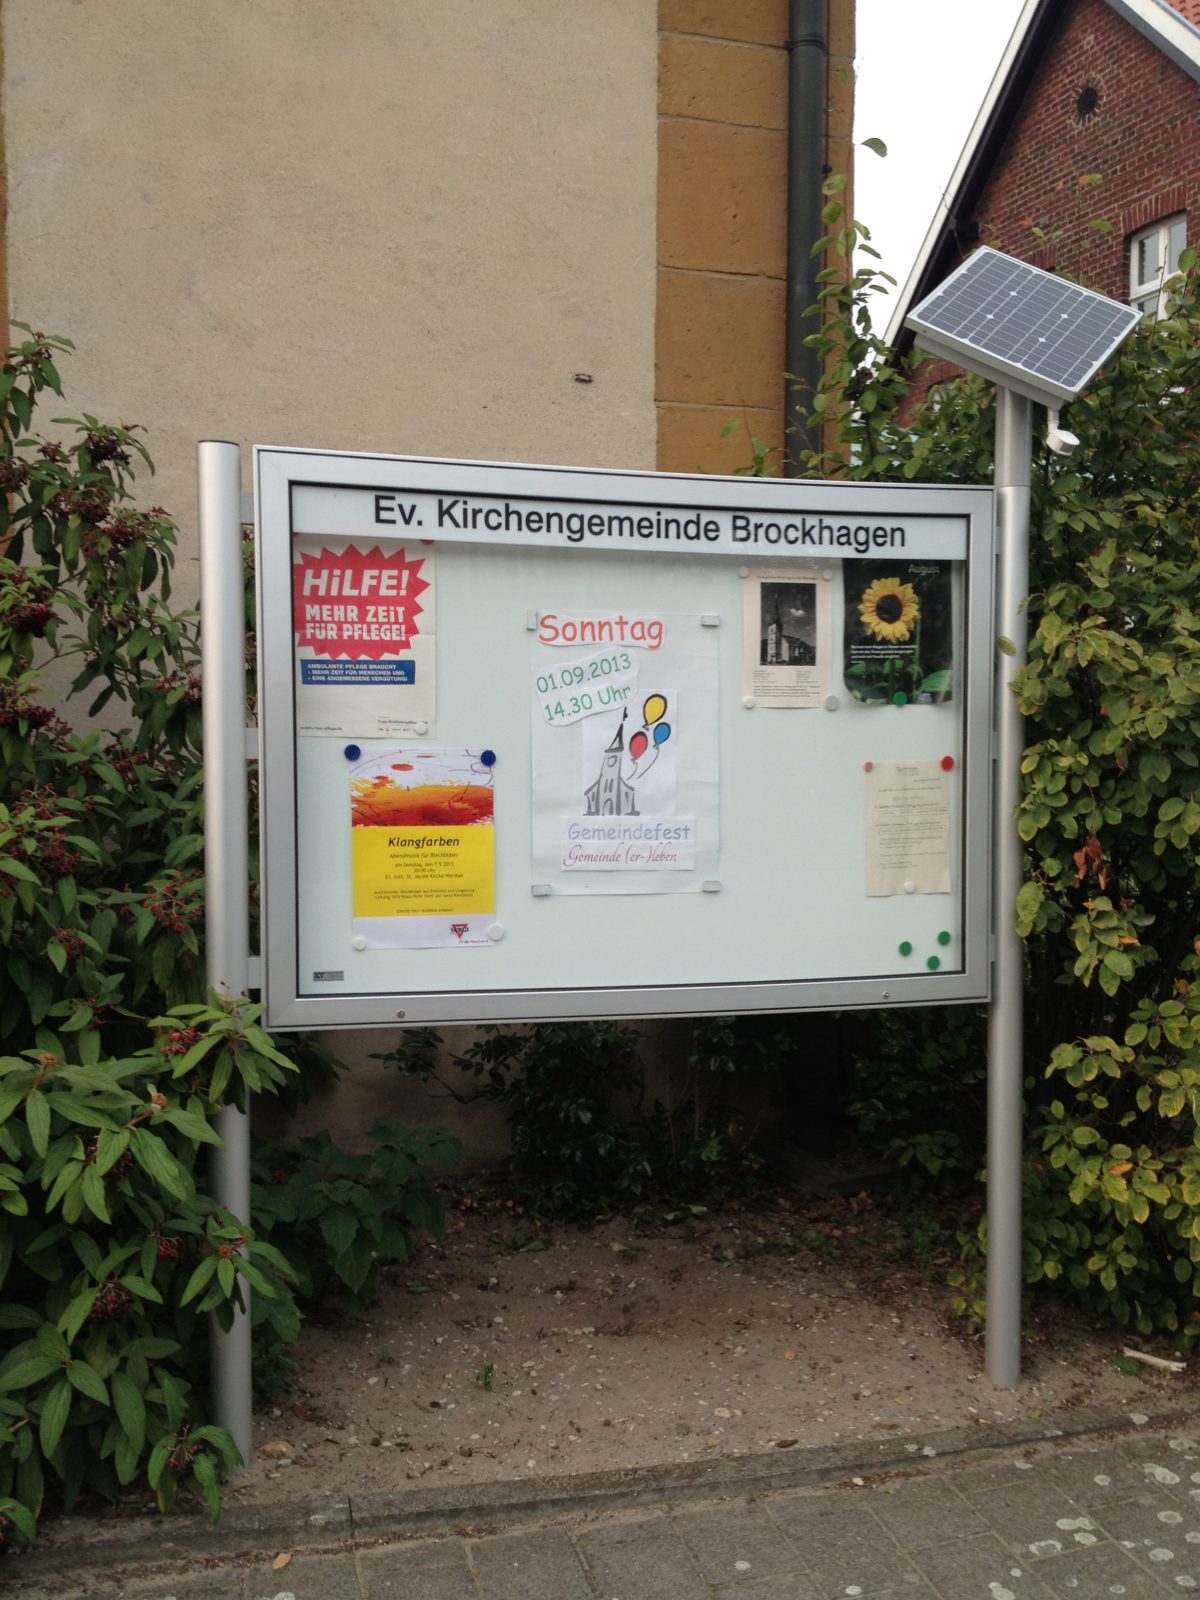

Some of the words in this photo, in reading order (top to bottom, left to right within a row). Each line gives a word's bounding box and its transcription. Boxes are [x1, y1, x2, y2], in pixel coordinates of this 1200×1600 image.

[374, 494, 423, 526] Ev.
[437, 498, 720, 542] Kirchengemeinde
[731, 514, 906, 553] Brockhagen
[305, 604, 359, 622] MEHR
[342, 624, 406, 641] PFLEGE!
[538, 614, 664, 650] Sonntag
[536, 653, 632, 693] 01.09.2013
[544, 693, 593, 721] 14.30
[597, 685, 632, 705] Uhr
[388, 837, 460, 849] Klangfarben
[568, 823, 691, 840] Gemeindefest
[563, 842, 624, 867] Gemeinde
